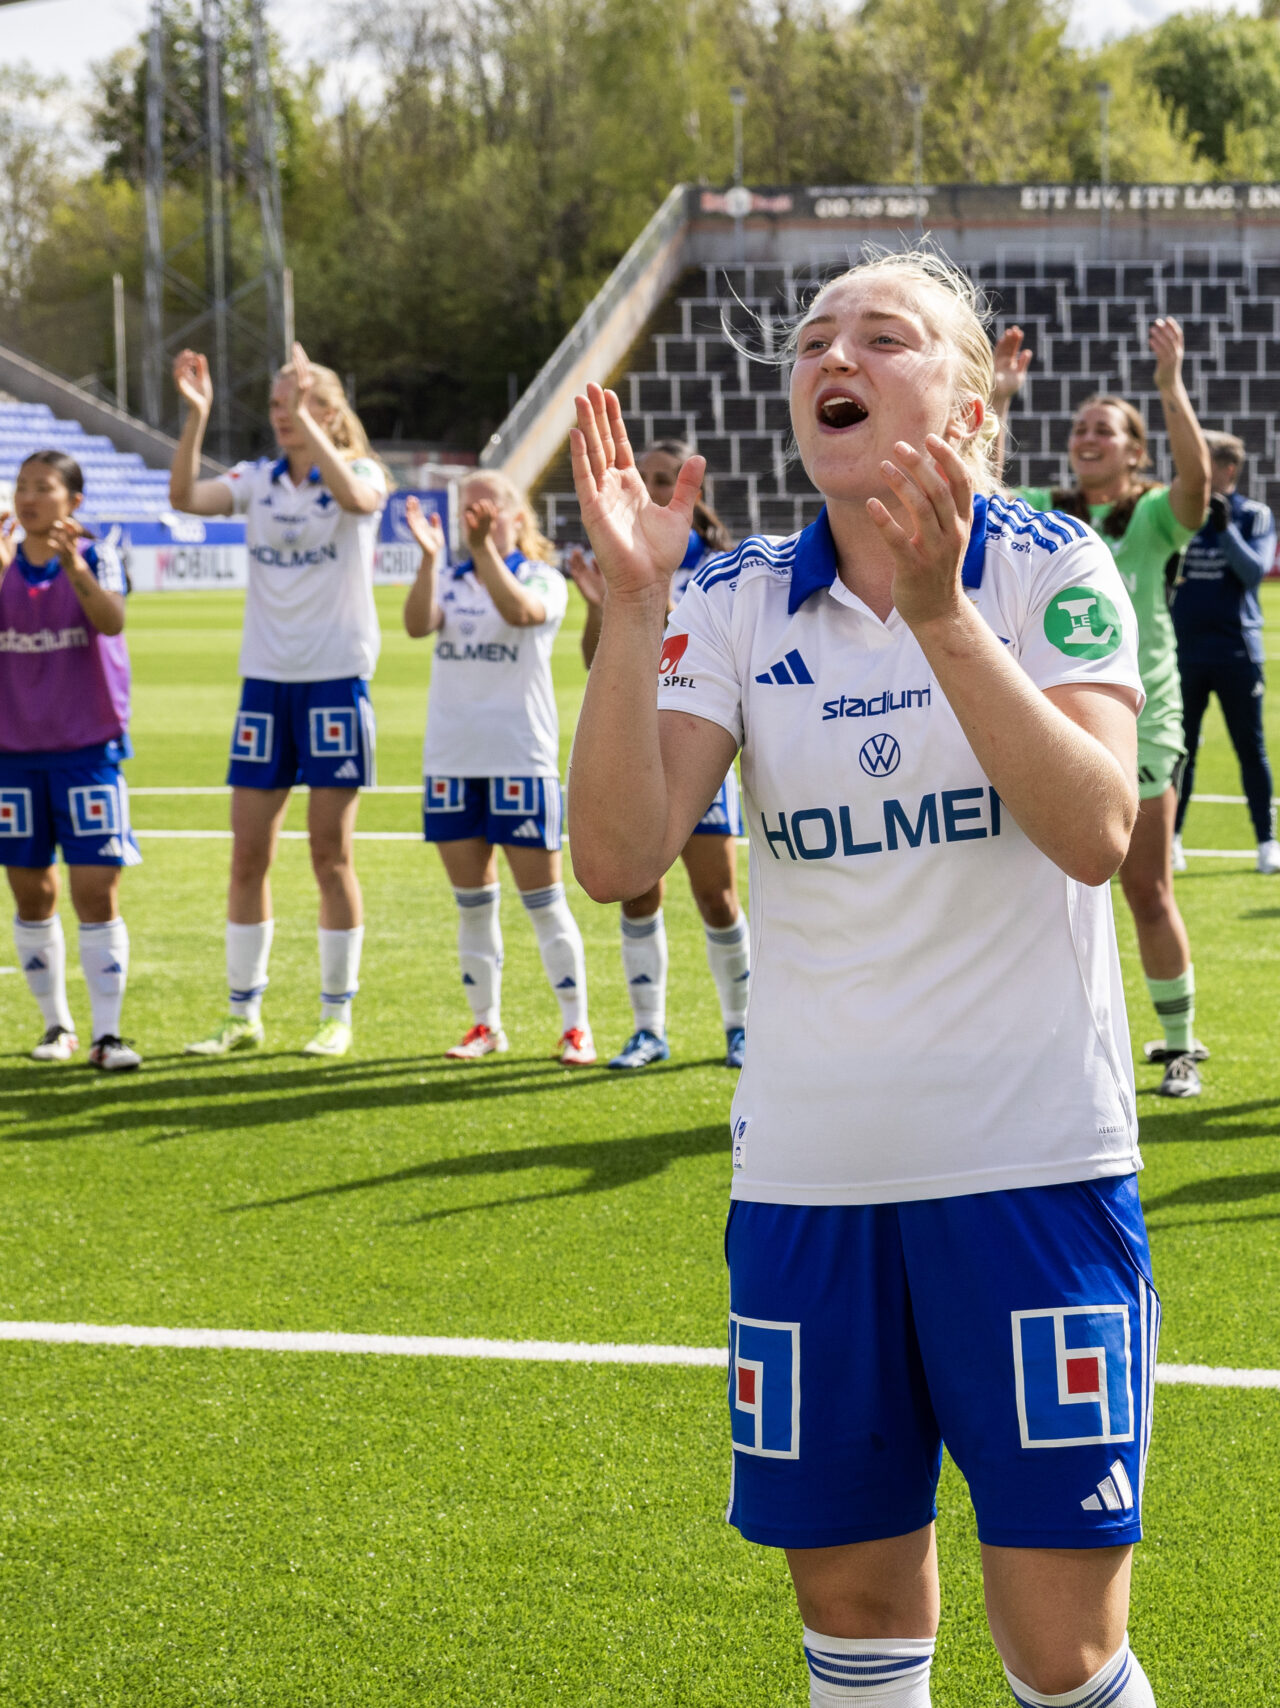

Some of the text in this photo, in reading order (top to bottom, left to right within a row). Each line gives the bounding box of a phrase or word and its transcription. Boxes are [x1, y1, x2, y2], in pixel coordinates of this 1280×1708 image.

[1020, 186, 1070, 210] ETT
[1129, 186, 1179, 210] ETT
[437, 641, 518, 662] OLMEN
[663, 675, 696, 689] SPEL
[822, 684, 931, 721] stadium
